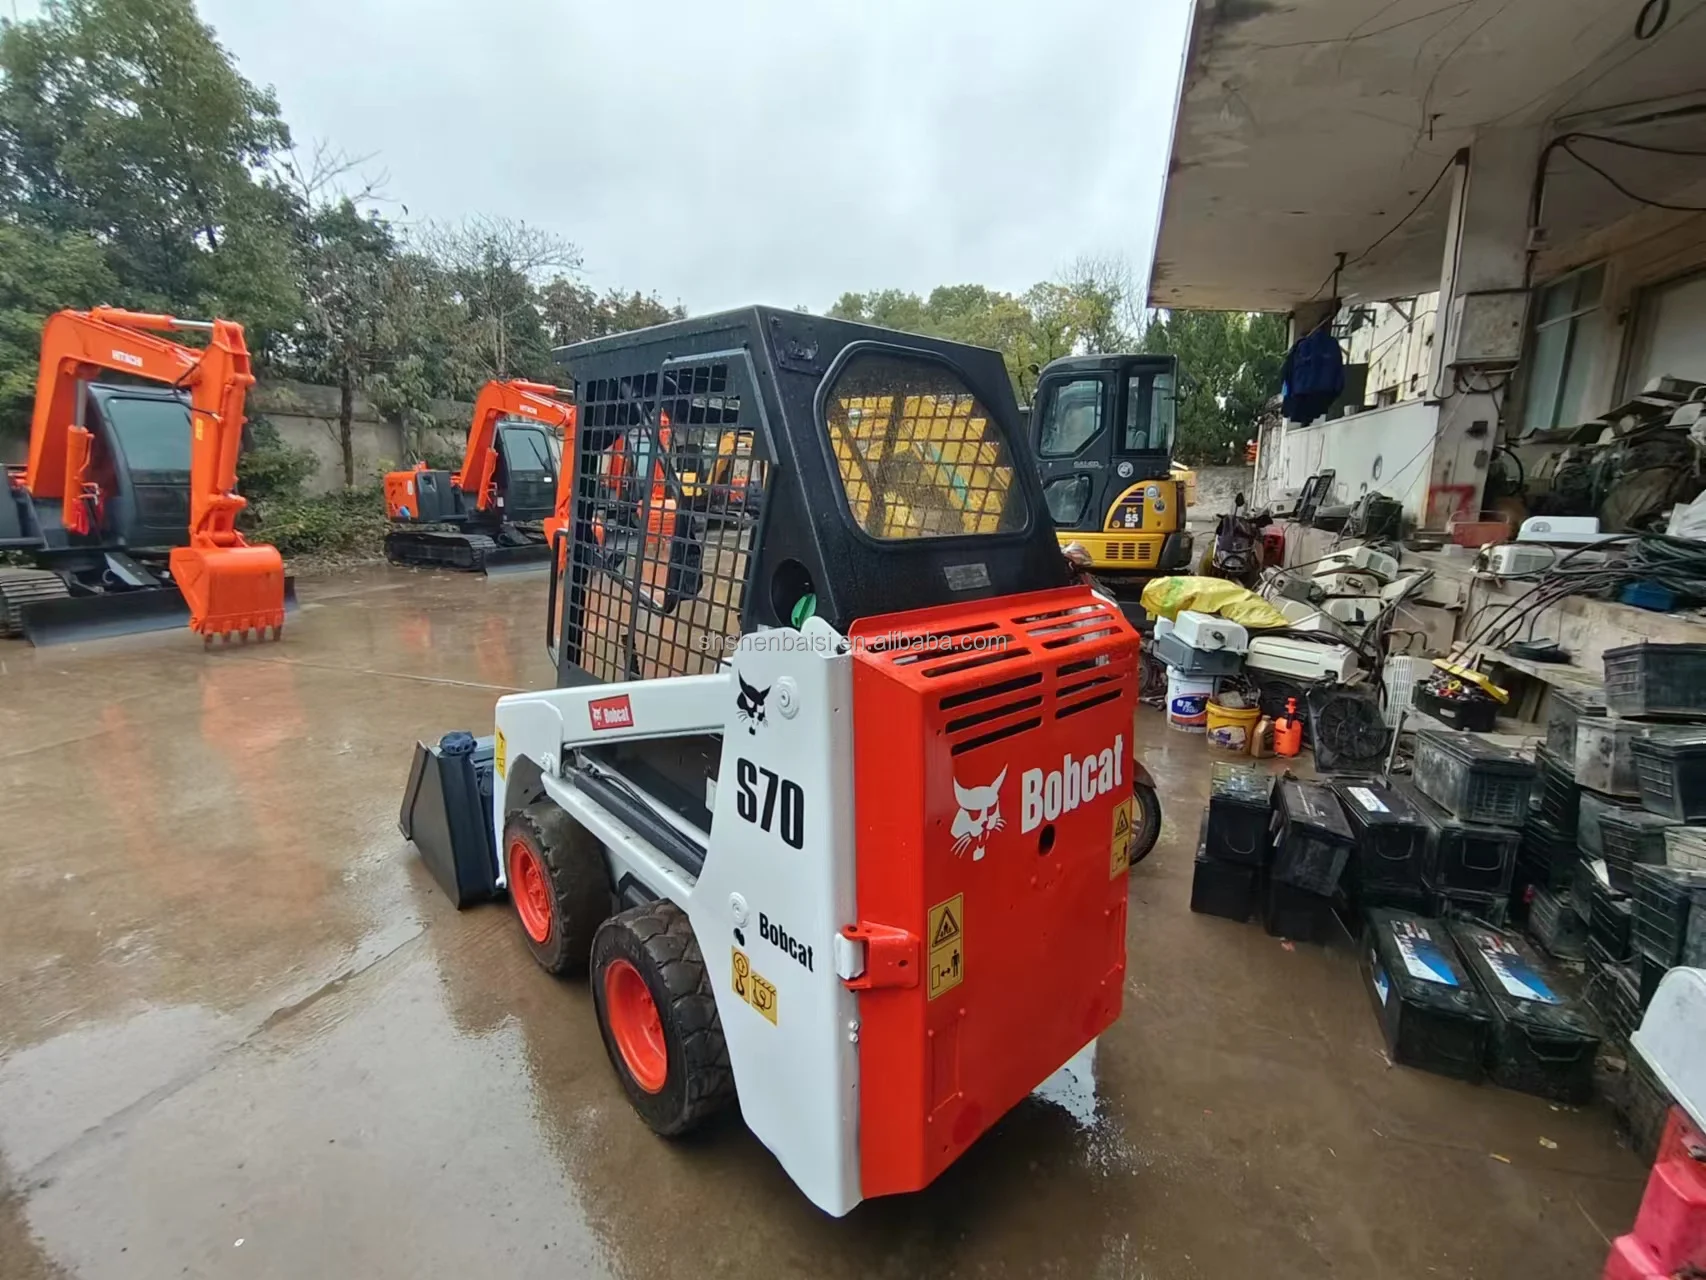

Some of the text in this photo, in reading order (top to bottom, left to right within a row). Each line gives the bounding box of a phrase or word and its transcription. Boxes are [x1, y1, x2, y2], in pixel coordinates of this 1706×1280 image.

[1124, 513, 1139, 523] 55
[603, 705, 630, 724] Bobcat
[737, 757, 804, 850] S70
[1021, 733, 1123, 835] Bobcat
[759, 911, 813, 973] Bobcat
